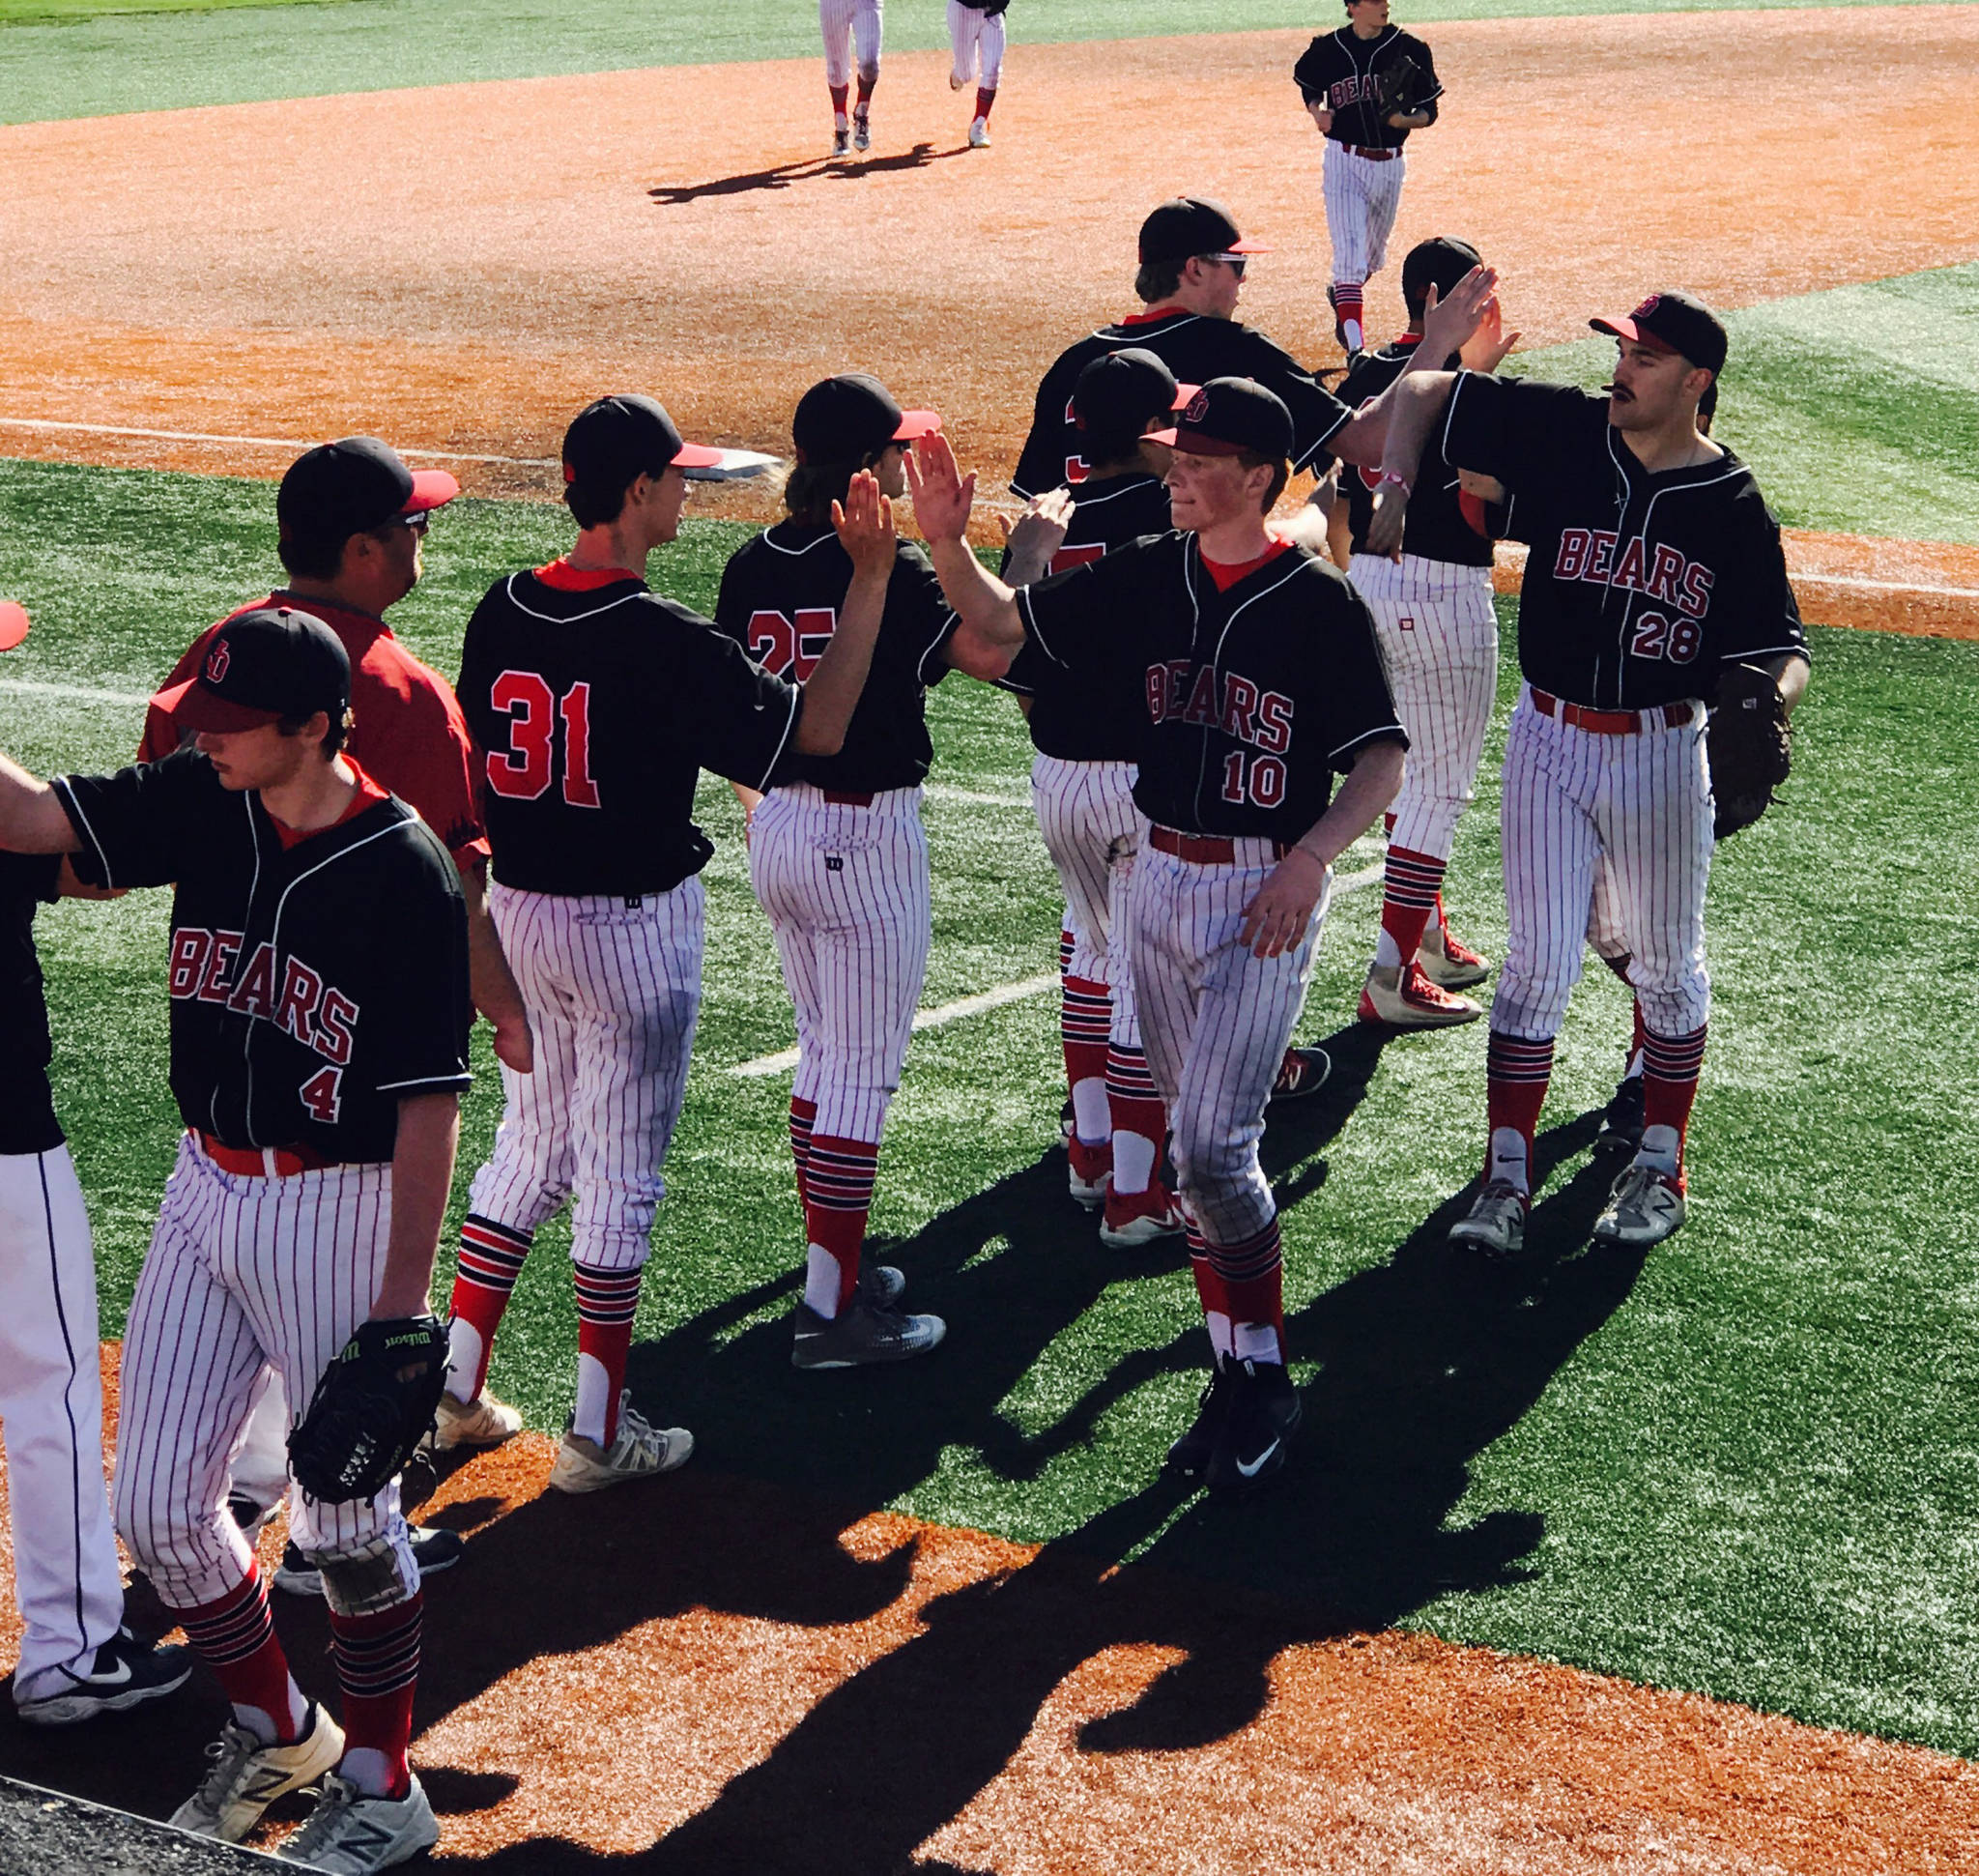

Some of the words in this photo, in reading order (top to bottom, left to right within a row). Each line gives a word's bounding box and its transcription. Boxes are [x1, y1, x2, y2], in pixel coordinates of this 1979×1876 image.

[1331, 73, 1385, 109] BEA
[1553, 528, 1715, 619] BEARS
[1630, 611, 1703, 665] 28
[1145, 658, 1295, 755] BEARS
[486, 669, 602, 809] 31
[1221, 750, 1287, 809] 10
[169, 927, 360, 1065] BEARS
[299, 1065, 343, 1124] 4
[385, 1331, 432, 1350] Wilson
